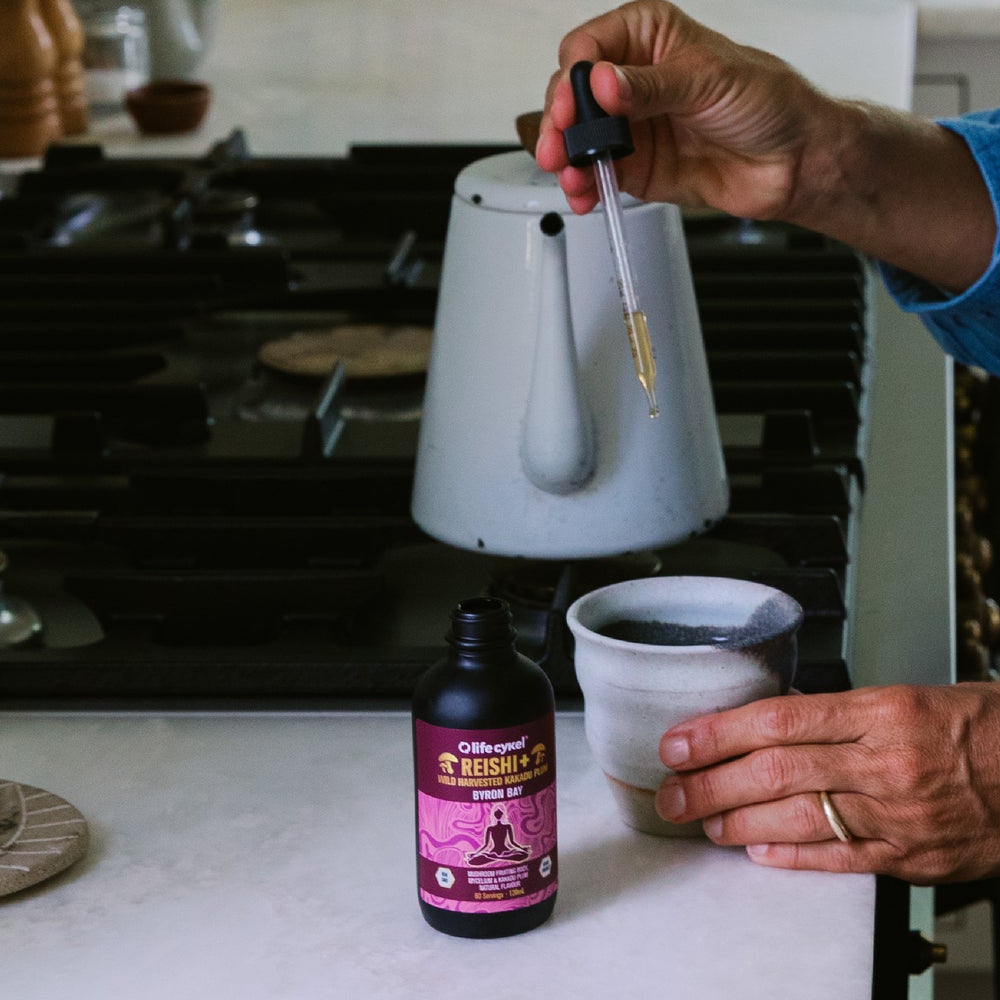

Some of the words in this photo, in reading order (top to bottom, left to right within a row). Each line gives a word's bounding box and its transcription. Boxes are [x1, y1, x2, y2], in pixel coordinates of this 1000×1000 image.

[437, 774, 457, 787] WILD
[457, 776, 503, 788] HARVESTED
[504, 771, 533, 785] KAKADU
[472, 789, 504, 801] BYRON
[506, 785, 524, 799] BAY
